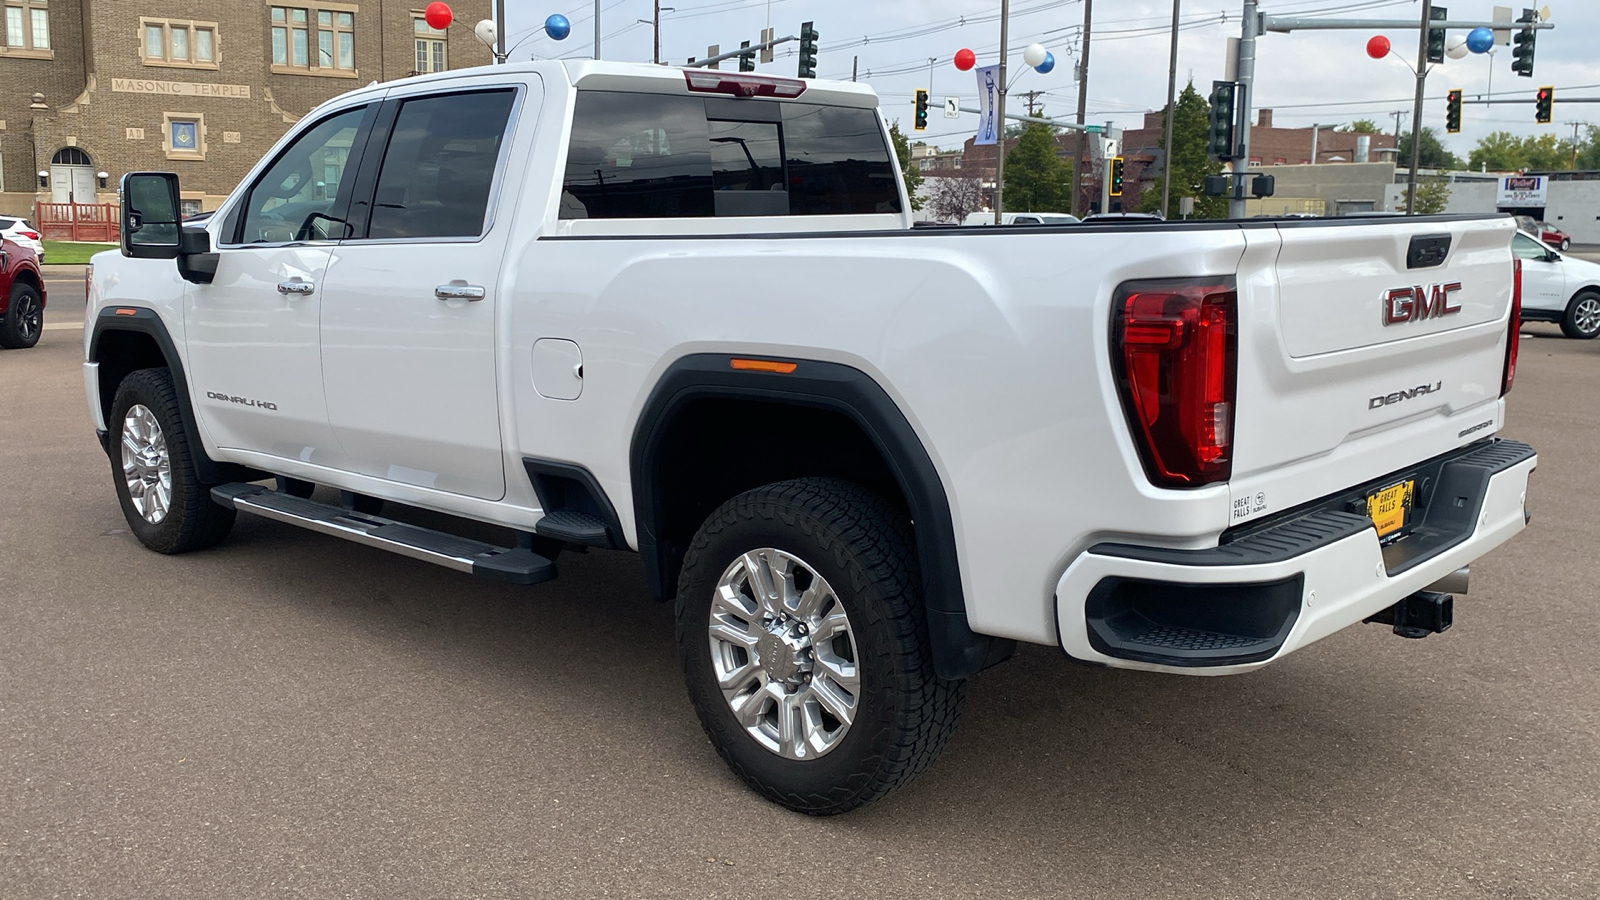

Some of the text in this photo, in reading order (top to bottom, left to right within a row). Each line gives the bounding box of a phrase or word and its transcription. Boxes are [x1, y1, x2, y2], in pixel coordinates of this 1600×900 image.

[114, 79, 248, 97] MASONIC TEMPLE
[224, 132, 240, 141] 1914
[1380, 281, 1462, 327] GMC
[206, 391, 278, 411] DENALI HD
[1368, 380, 1442, 410] DENALI
[1233, 496, 1250, 509] GREAT
[1380, 489, 1398, 504] GREAT
[1233, 505, 1250, 519] FALLS
[1378, 500, 1396, 515] FALLS
